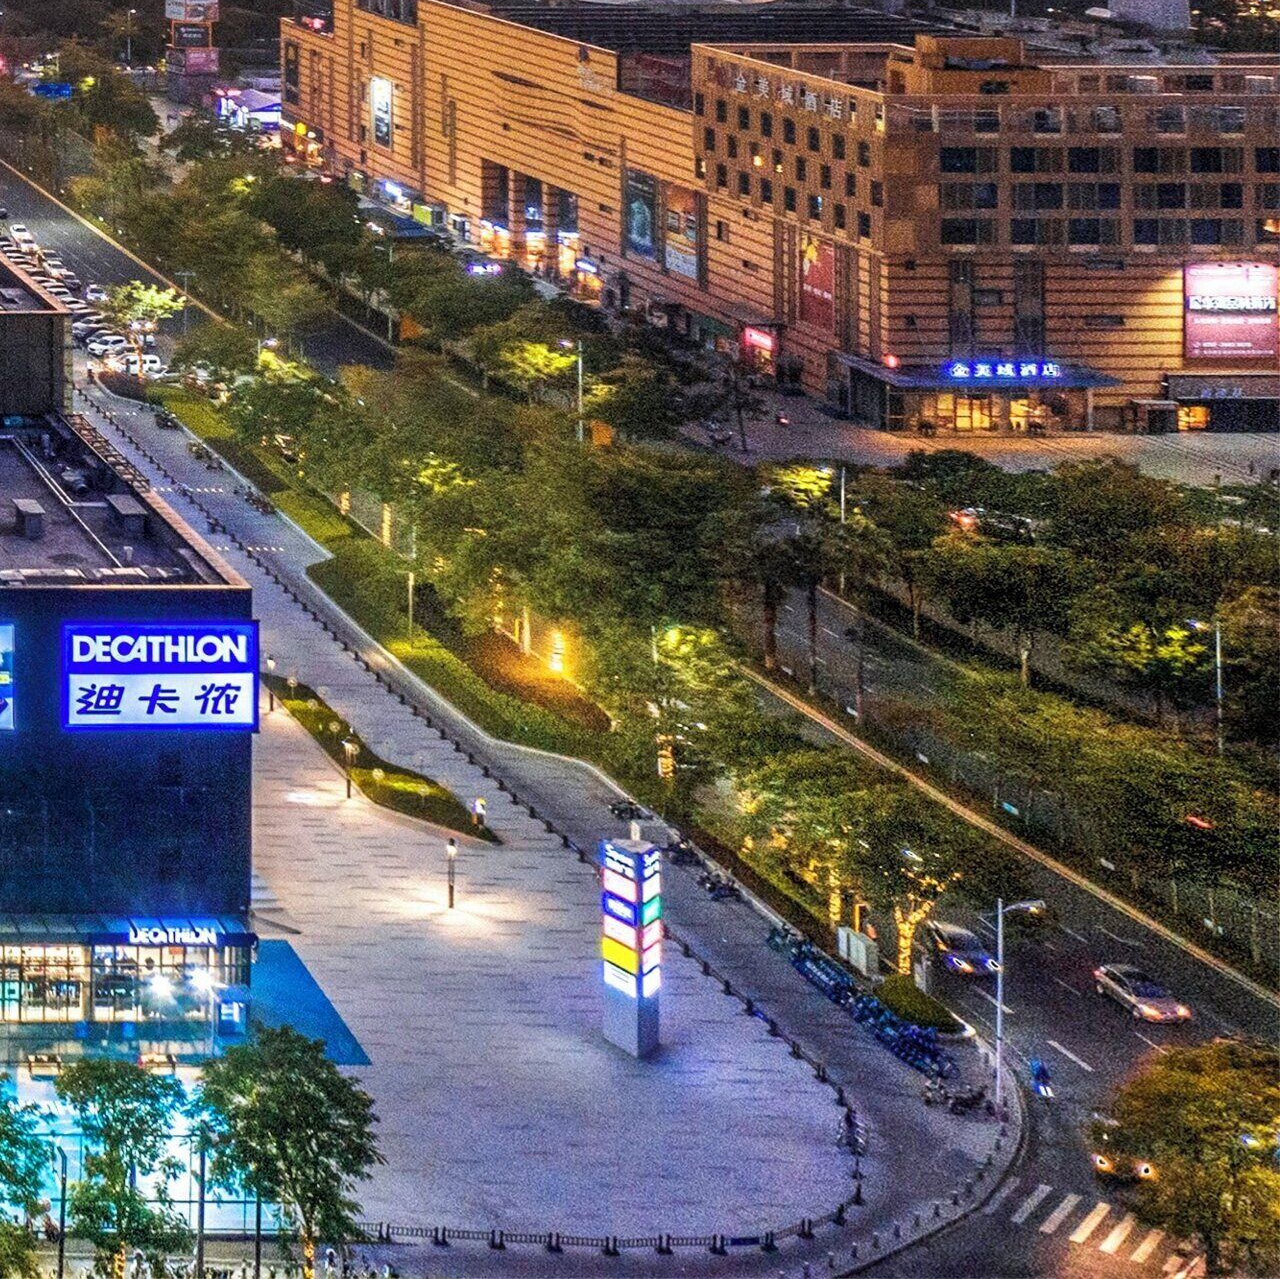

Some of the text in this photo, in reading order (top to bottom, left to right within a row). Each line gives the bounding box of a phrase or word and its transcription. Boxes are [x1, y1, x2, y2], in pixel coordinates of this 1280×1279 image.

[72, 634, 247, 663] DECATHLON
[76, 682, 243, 716] 迪卡侬
